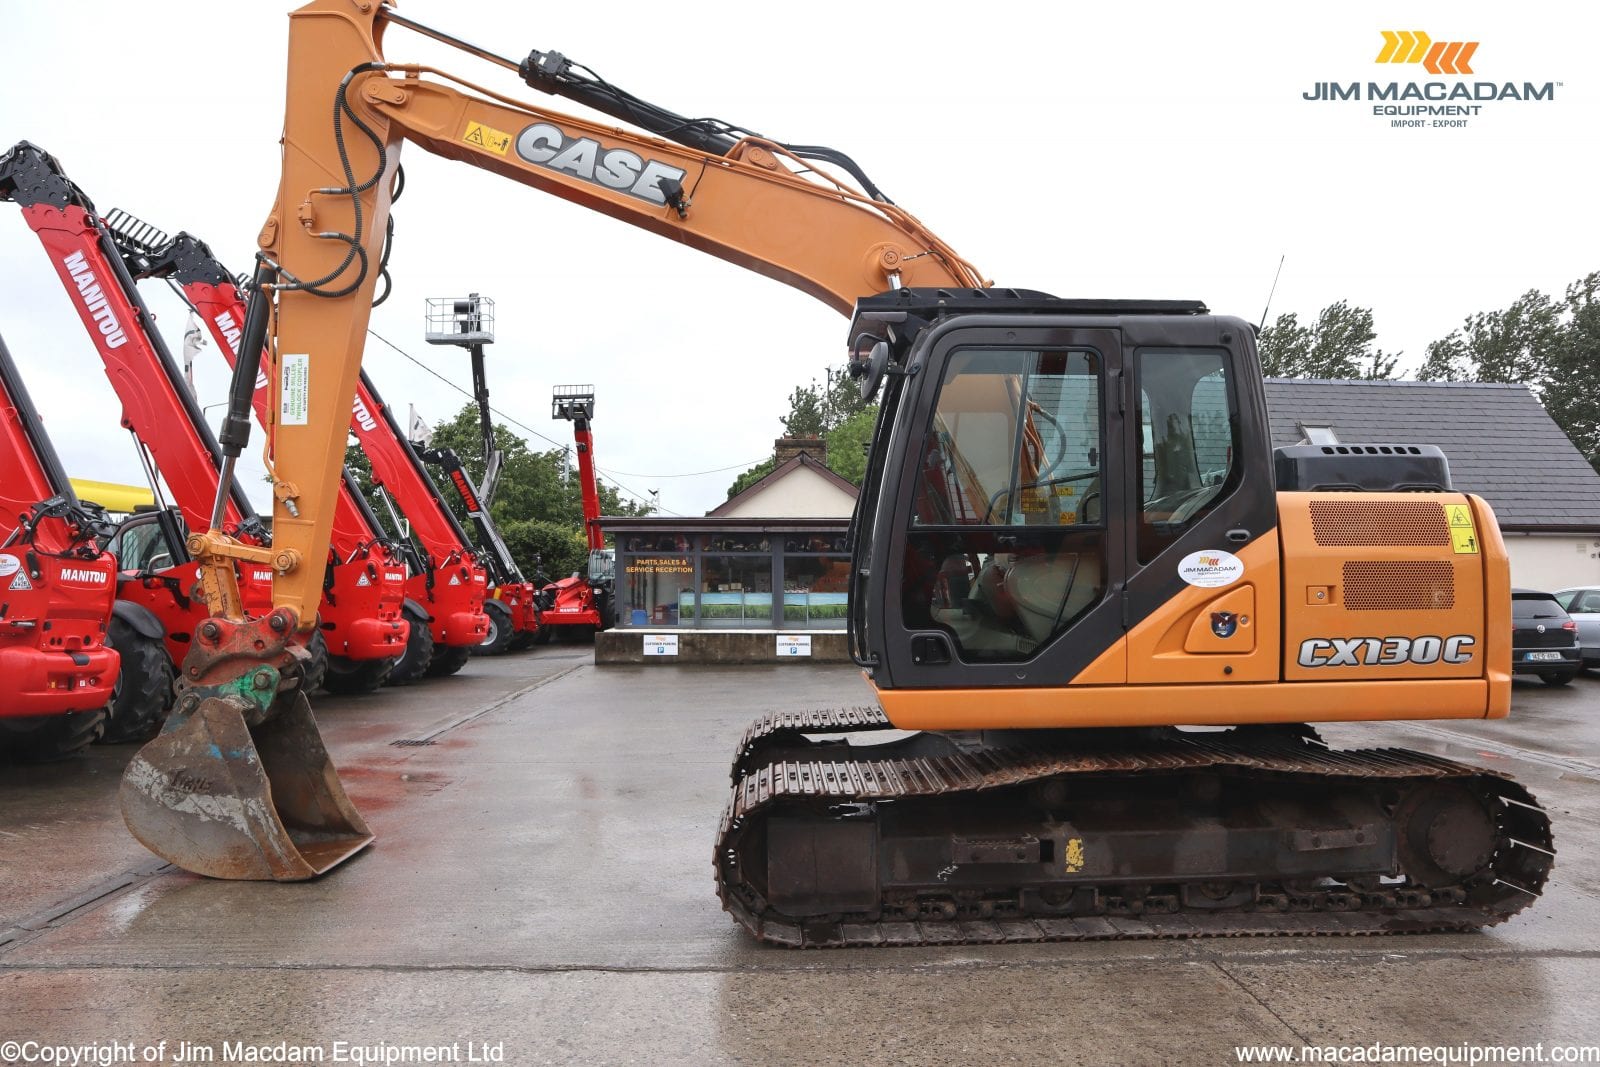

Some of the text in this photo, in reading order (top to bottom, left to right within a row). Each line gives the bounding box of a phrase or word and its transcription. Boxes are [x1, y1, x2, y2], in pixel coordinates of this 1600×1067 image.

[516, 122, 687, 206] CASE
[63, 248, 128, 349] MANITOU
[451, 470, 478, 511] MANITOU
[61, 568, 106, 583] MANITOU
[1298, 635, 1475, 667] CX130C
